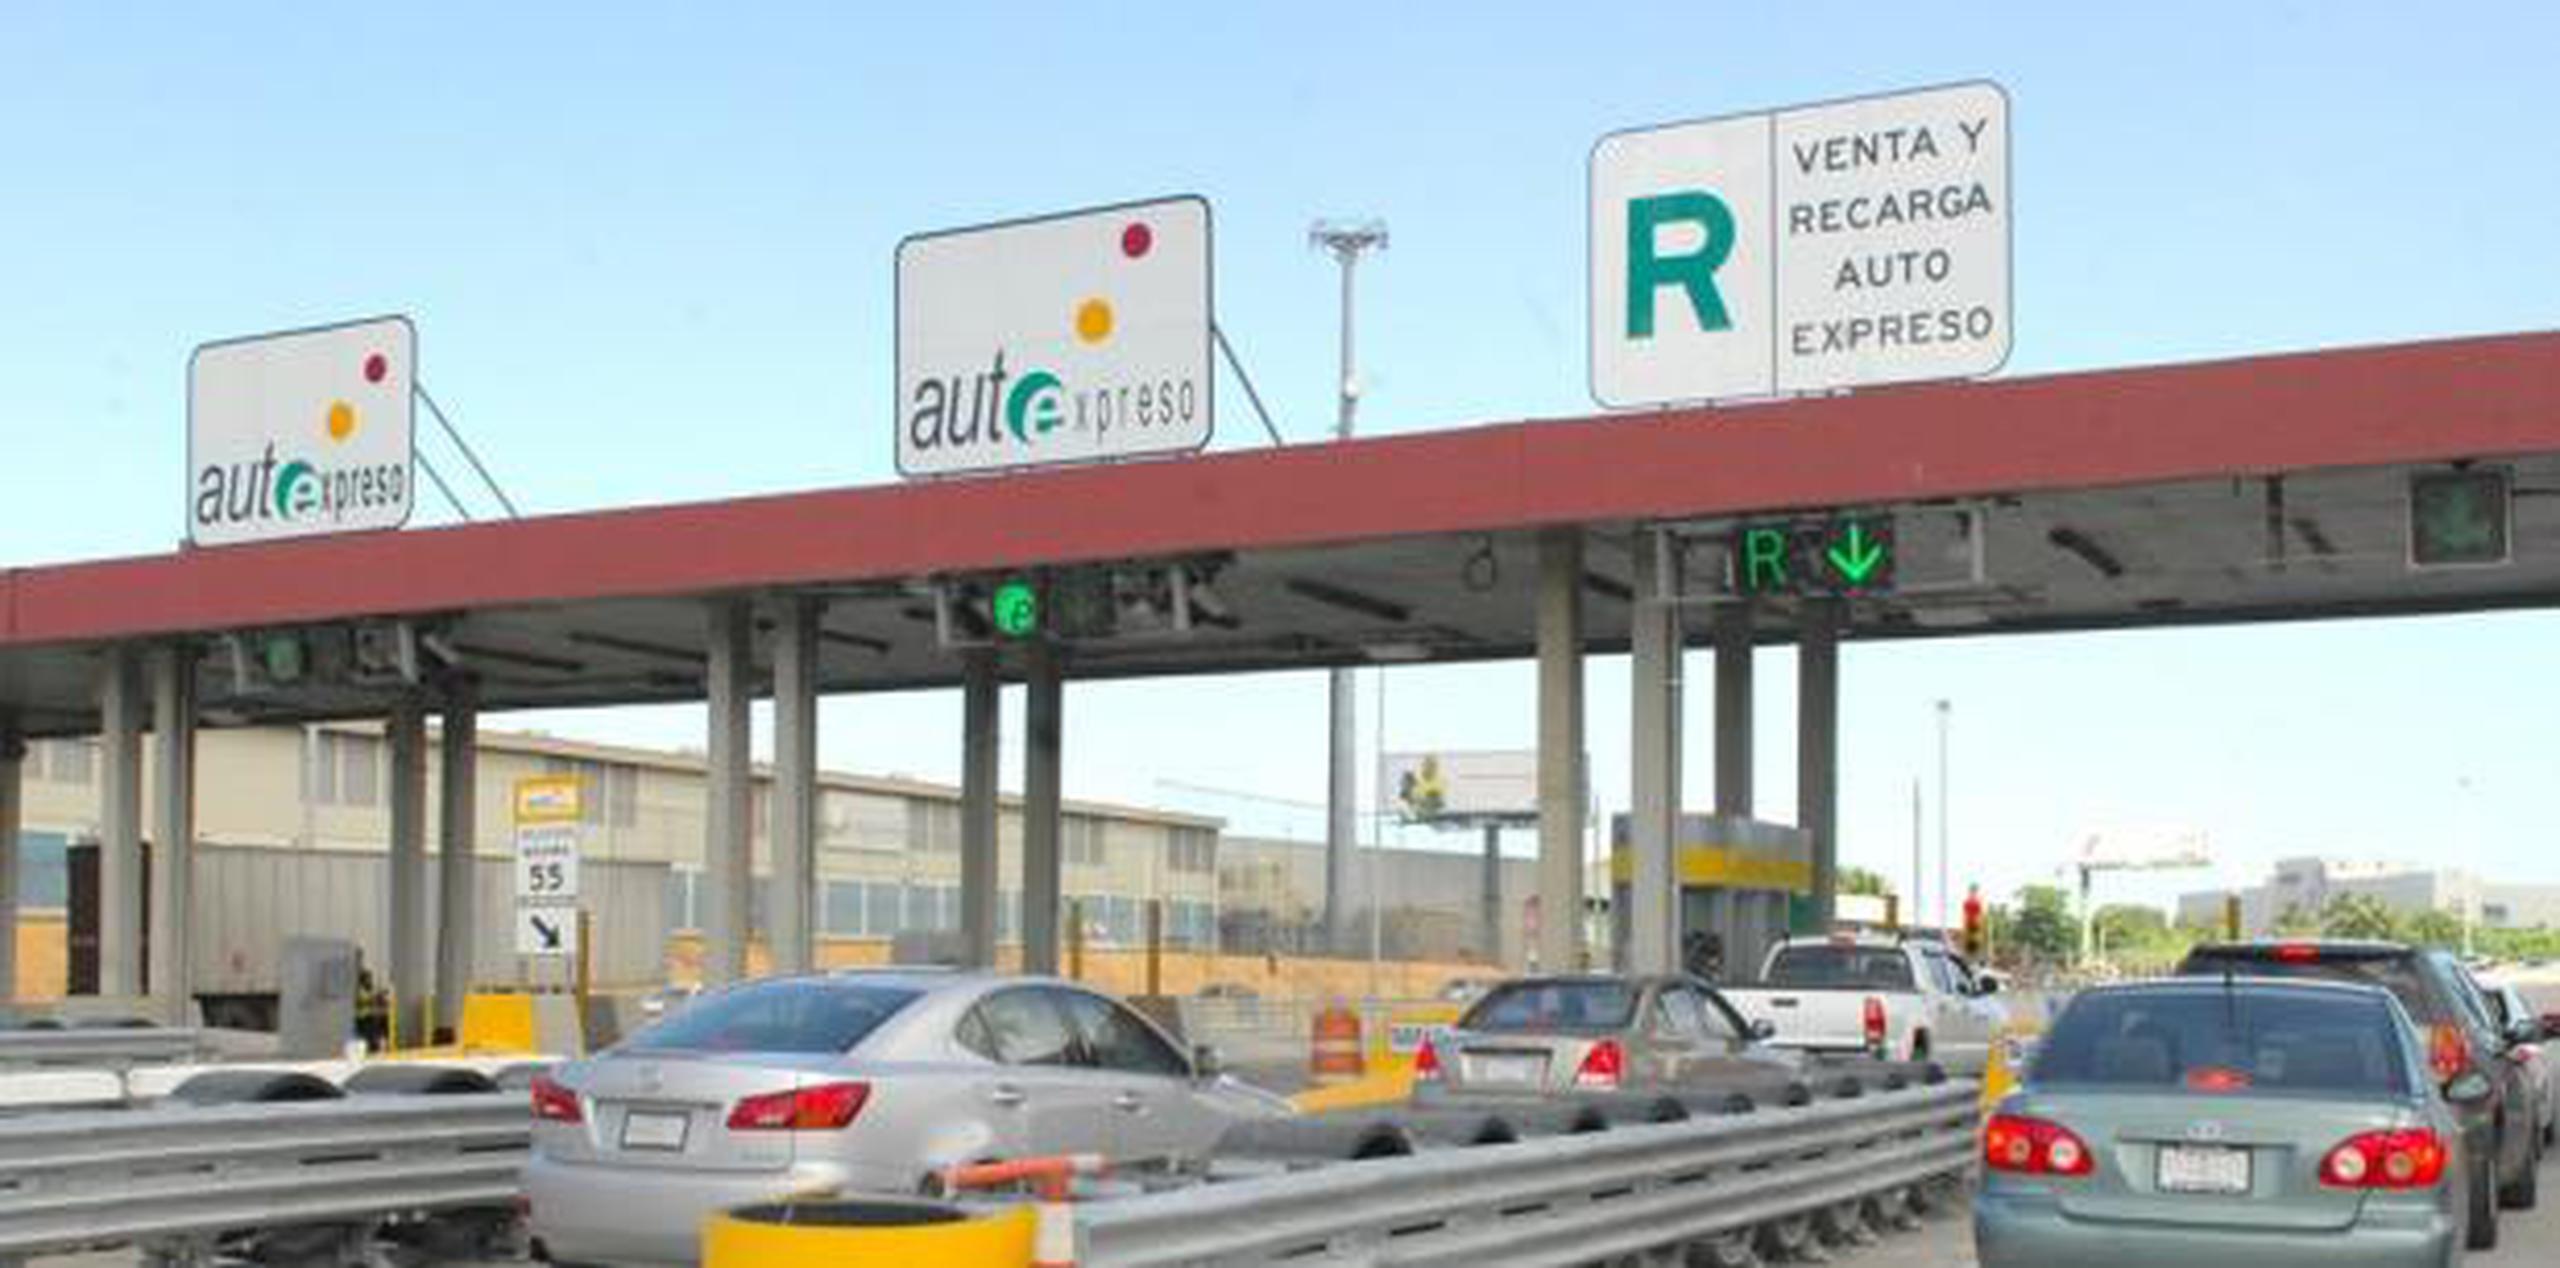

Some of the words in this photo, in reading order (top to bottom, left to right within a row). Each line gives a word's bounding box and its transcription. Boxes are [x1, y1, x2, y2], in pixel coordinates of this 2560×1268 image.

[1793, 126, 1939, 175] VENTA
[1960, 117, 1988, 153] Y
[1789, 183, 1992, 234] RECARGA
[1626, 190, 1736, 339] R
[1834, 248, 1951, 291] AUTO
[1792, 307, 1994, 355] EXPRESO
[1745, 529, 1788, 591] R
[529, 863, 564, 892] 55
